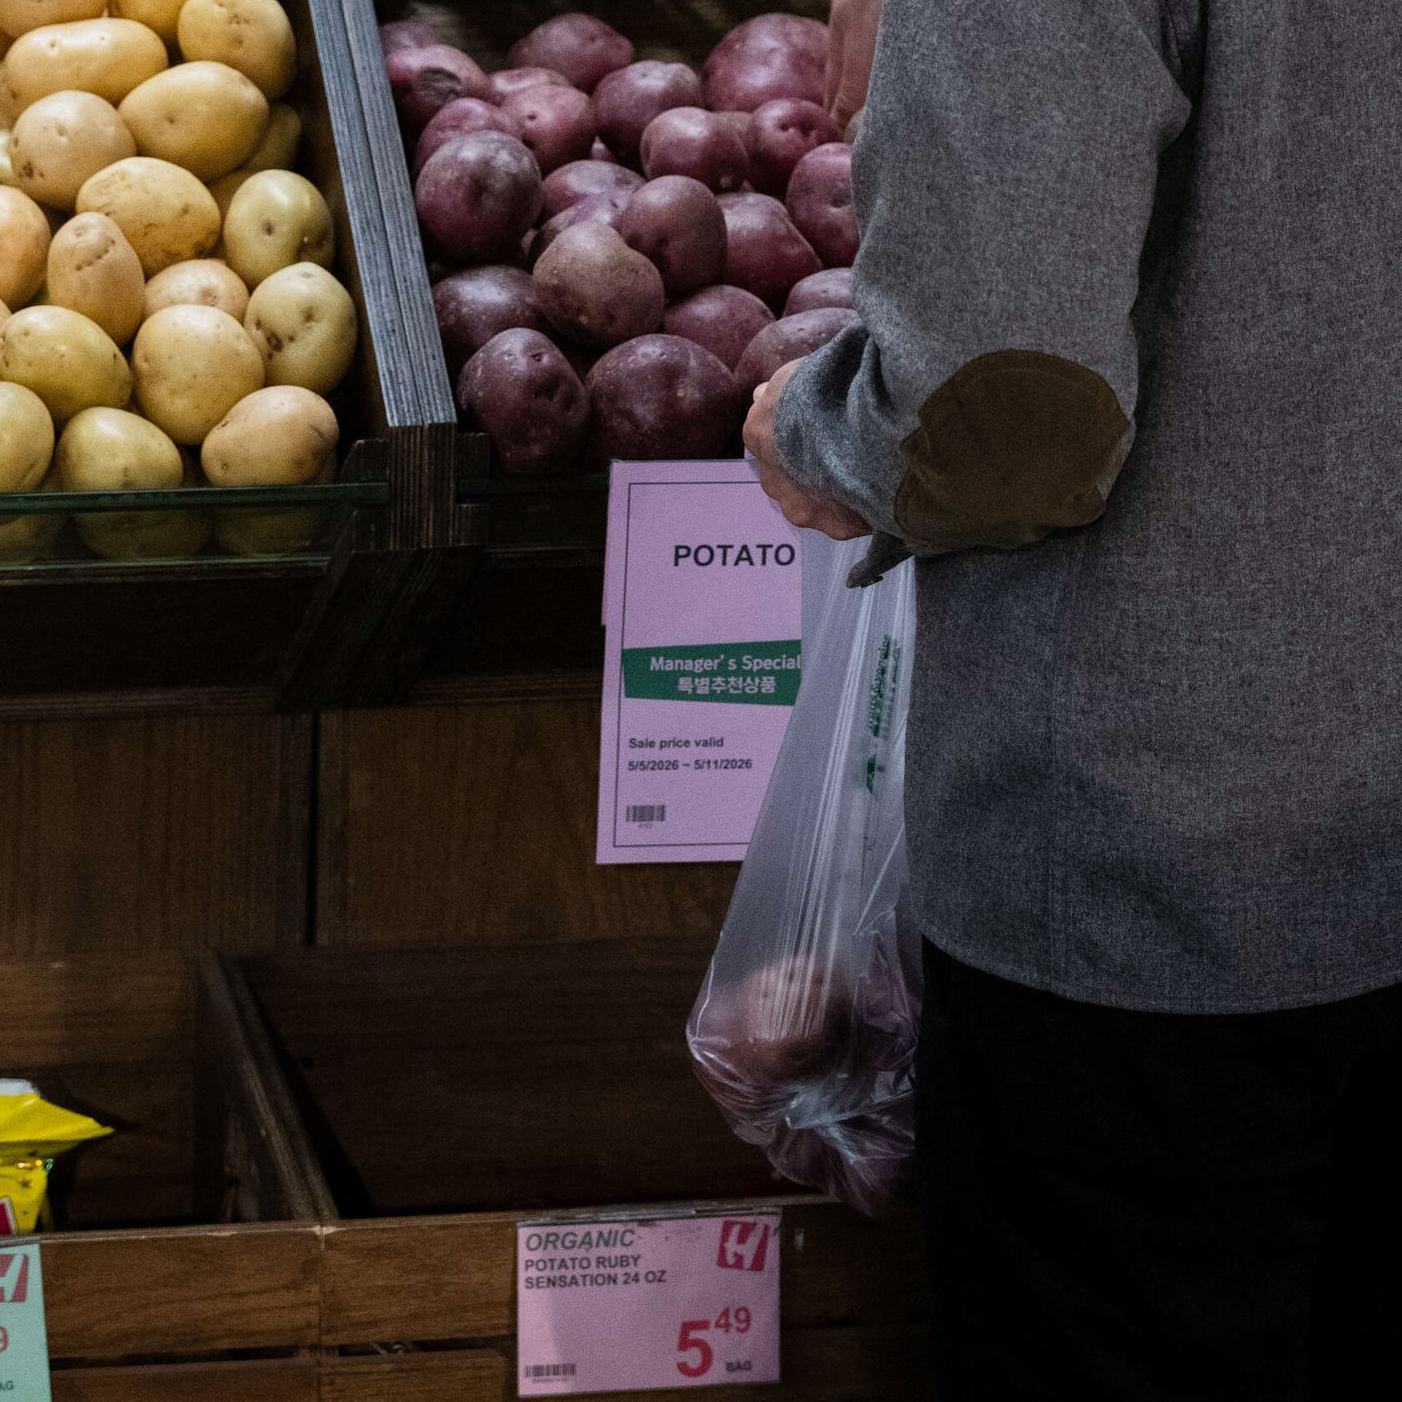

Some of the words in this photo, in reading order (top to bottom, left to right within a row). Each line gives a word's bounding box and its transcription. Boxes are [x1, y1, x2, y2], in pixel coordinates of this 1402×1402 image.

[673, 544, 796, 567] POTATO
[741, 654, 801, 670] Special
[677, 677, 777, 695] 특별추천상품
[628, 738, 656, 749] Sale
[659, 738, 691, 751] price
[694, 737, 725, 748] valid
[627, 759, 680, 771] 5/5/2026
[693, 758, 753, 771] 5/11/2026
[525, 1229, 636, 1252] ORGANIC
[524, 1257, 592, 1273] POTATO
[596, 1254, 641, 1268] RUBY
[524, 1273, 618, 1290] SENSATION
[622, 1272, 641, 1286] 24
[644, 1270, 668, 1284] OZ
[676, 1320, 713, 1378] 5
[714, 1306, 752, 1334] 49
[725, 1359, 753, 1373] BAG
